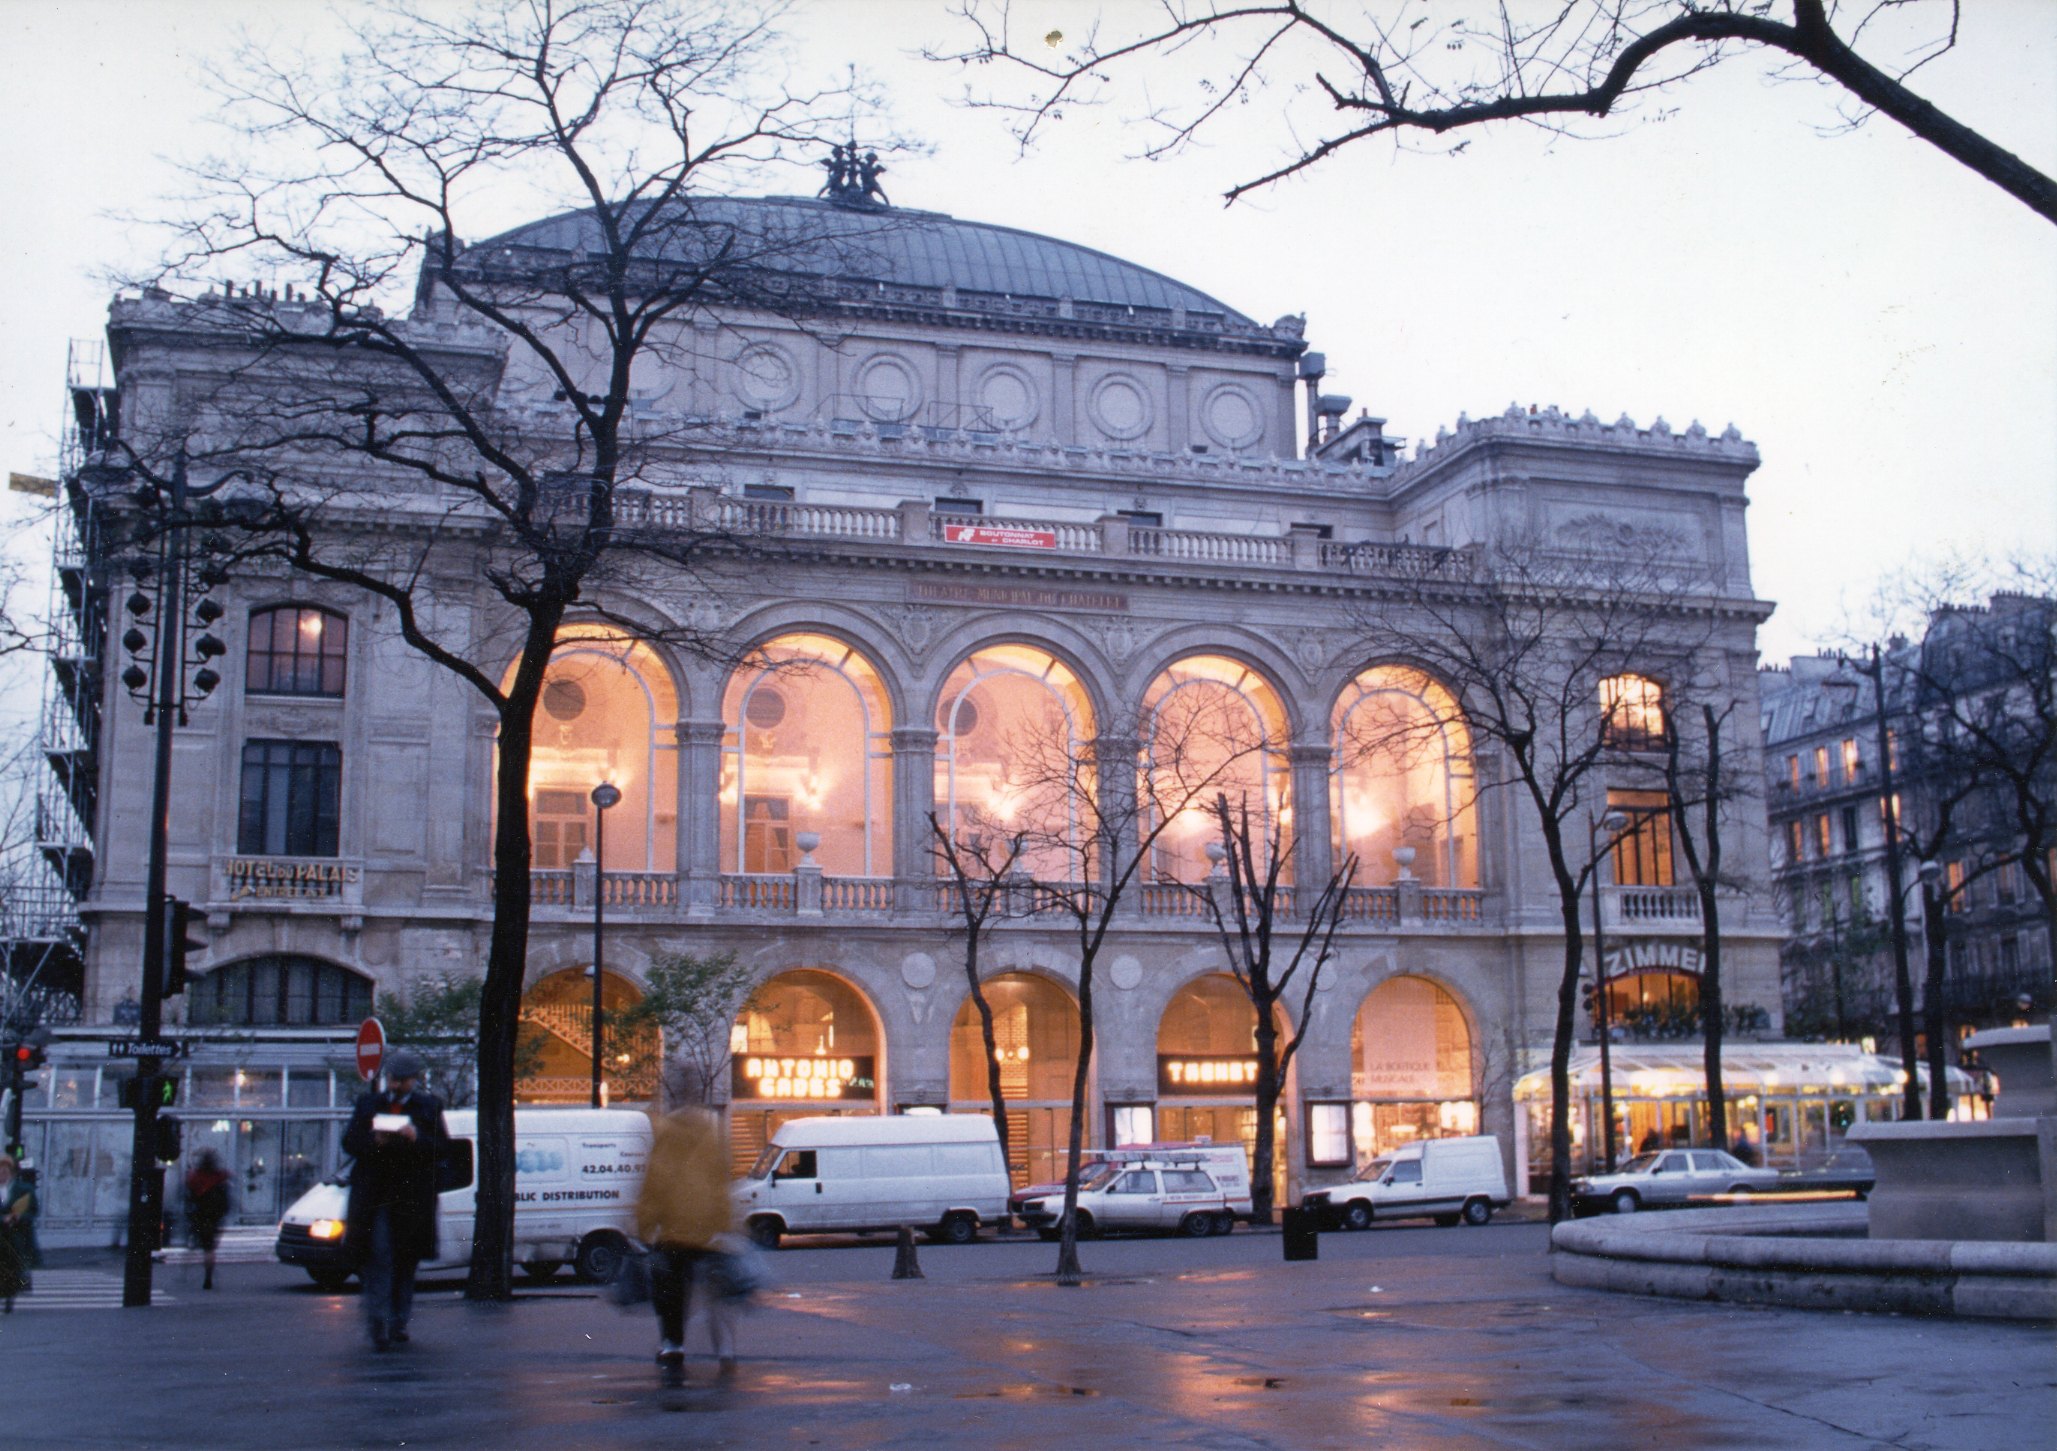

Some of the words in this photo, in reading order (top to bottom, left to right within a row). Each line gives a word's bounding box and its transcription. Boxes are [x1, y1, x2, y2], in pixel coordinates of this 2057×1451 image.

[978, 588, 1032, 603] MUNICIPAL
[295, 863, 358, 883] PALAIS
[127, 1042, 172, 1056] Toilettes
[746, 1058, 855, 1079] ANTONIO
[1168, 1061, 1258, 1082] TRENET
[758, 1077, 842, 1098] GADES
[543, 1190, 620, 1202] DISTRIBUTION
